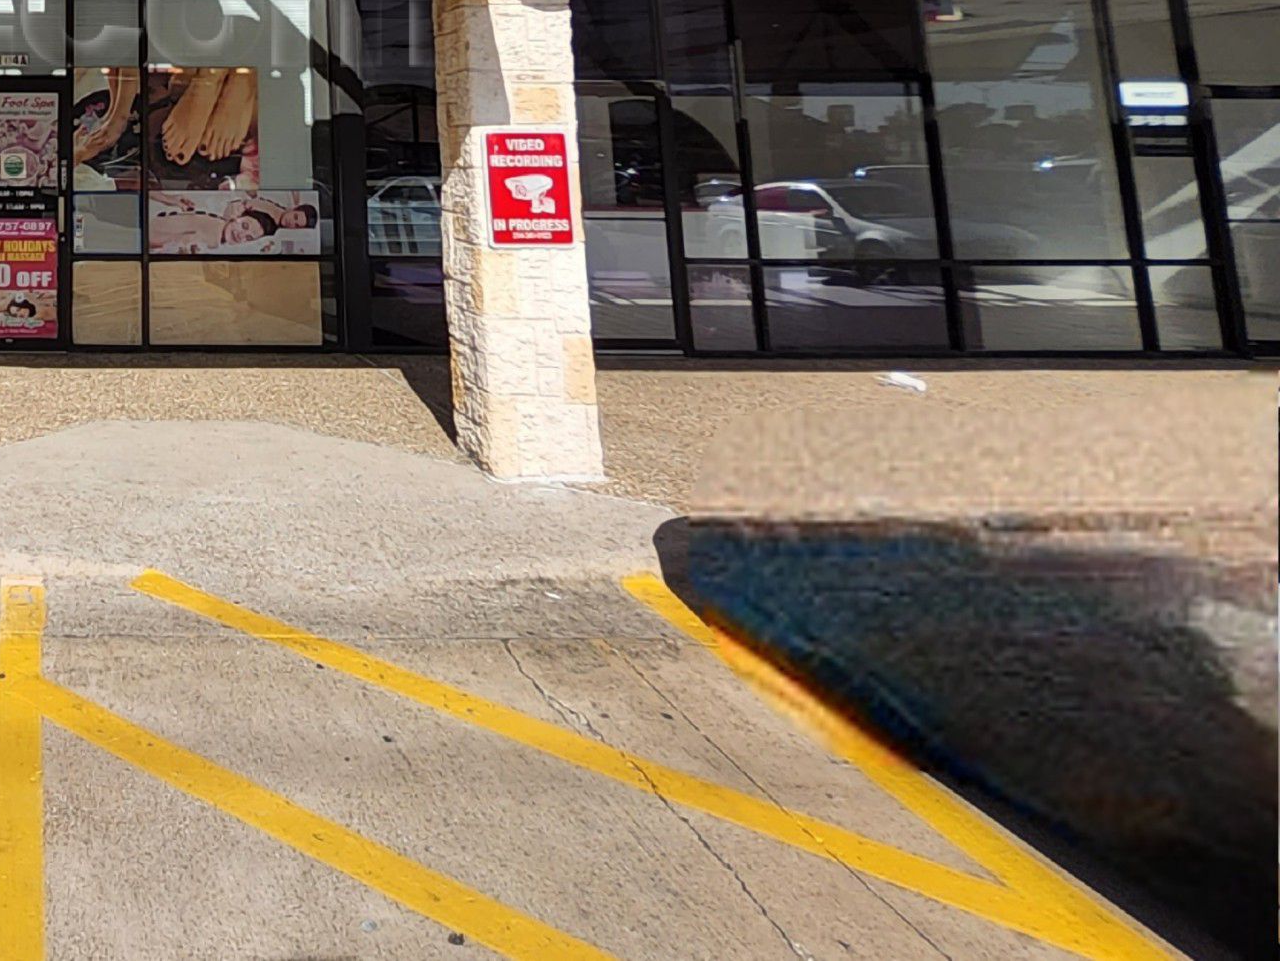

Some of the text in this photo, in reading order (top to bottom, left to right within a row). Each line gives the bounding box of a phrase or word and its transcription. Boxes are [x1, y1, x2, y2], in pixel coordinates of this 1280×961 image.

[2, 96, 29, 108] Foot
[31, 96, 56, 110] Spa
[505, 139, 545, 151] VIDEO
[489, 155, 564, 168] RECORDING
[493, 219, 570, 231] IN PROGRESS
[4, 240, 56, 253] HOLIDAYS
[16, 271, 52, 287] OFF
